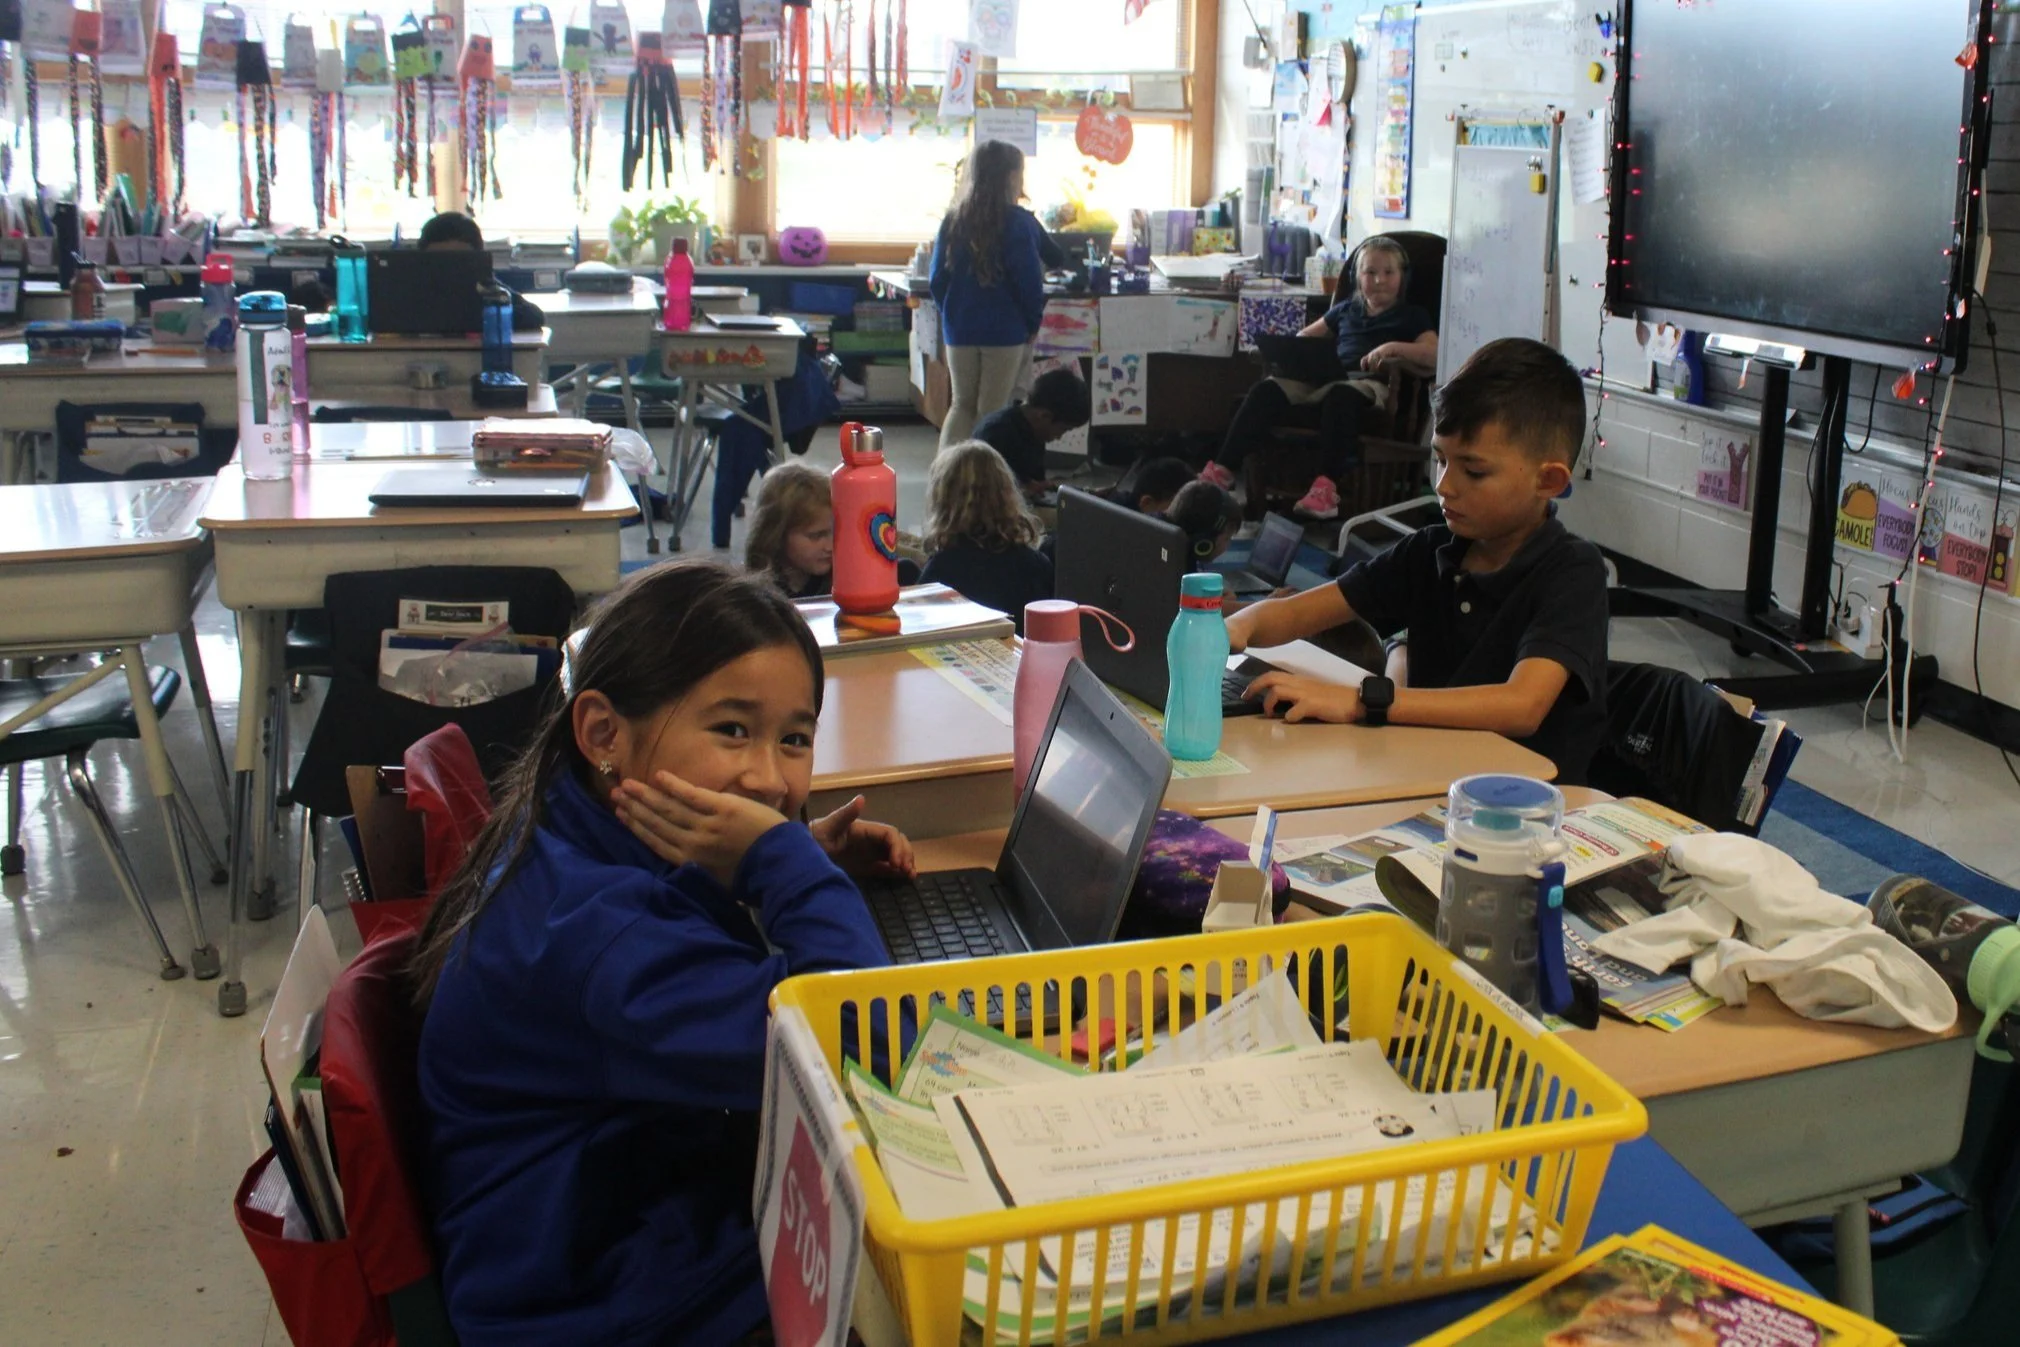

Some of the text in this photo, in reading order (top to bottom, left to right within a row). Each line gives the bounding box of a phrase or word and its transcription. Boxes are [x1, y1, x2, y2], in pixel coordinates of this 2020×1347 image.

[1917, 486, 1946, 511] Pcus
[1948, 494, 1983, 521] Hands
[783, 1166, 827, 1307] STOP
